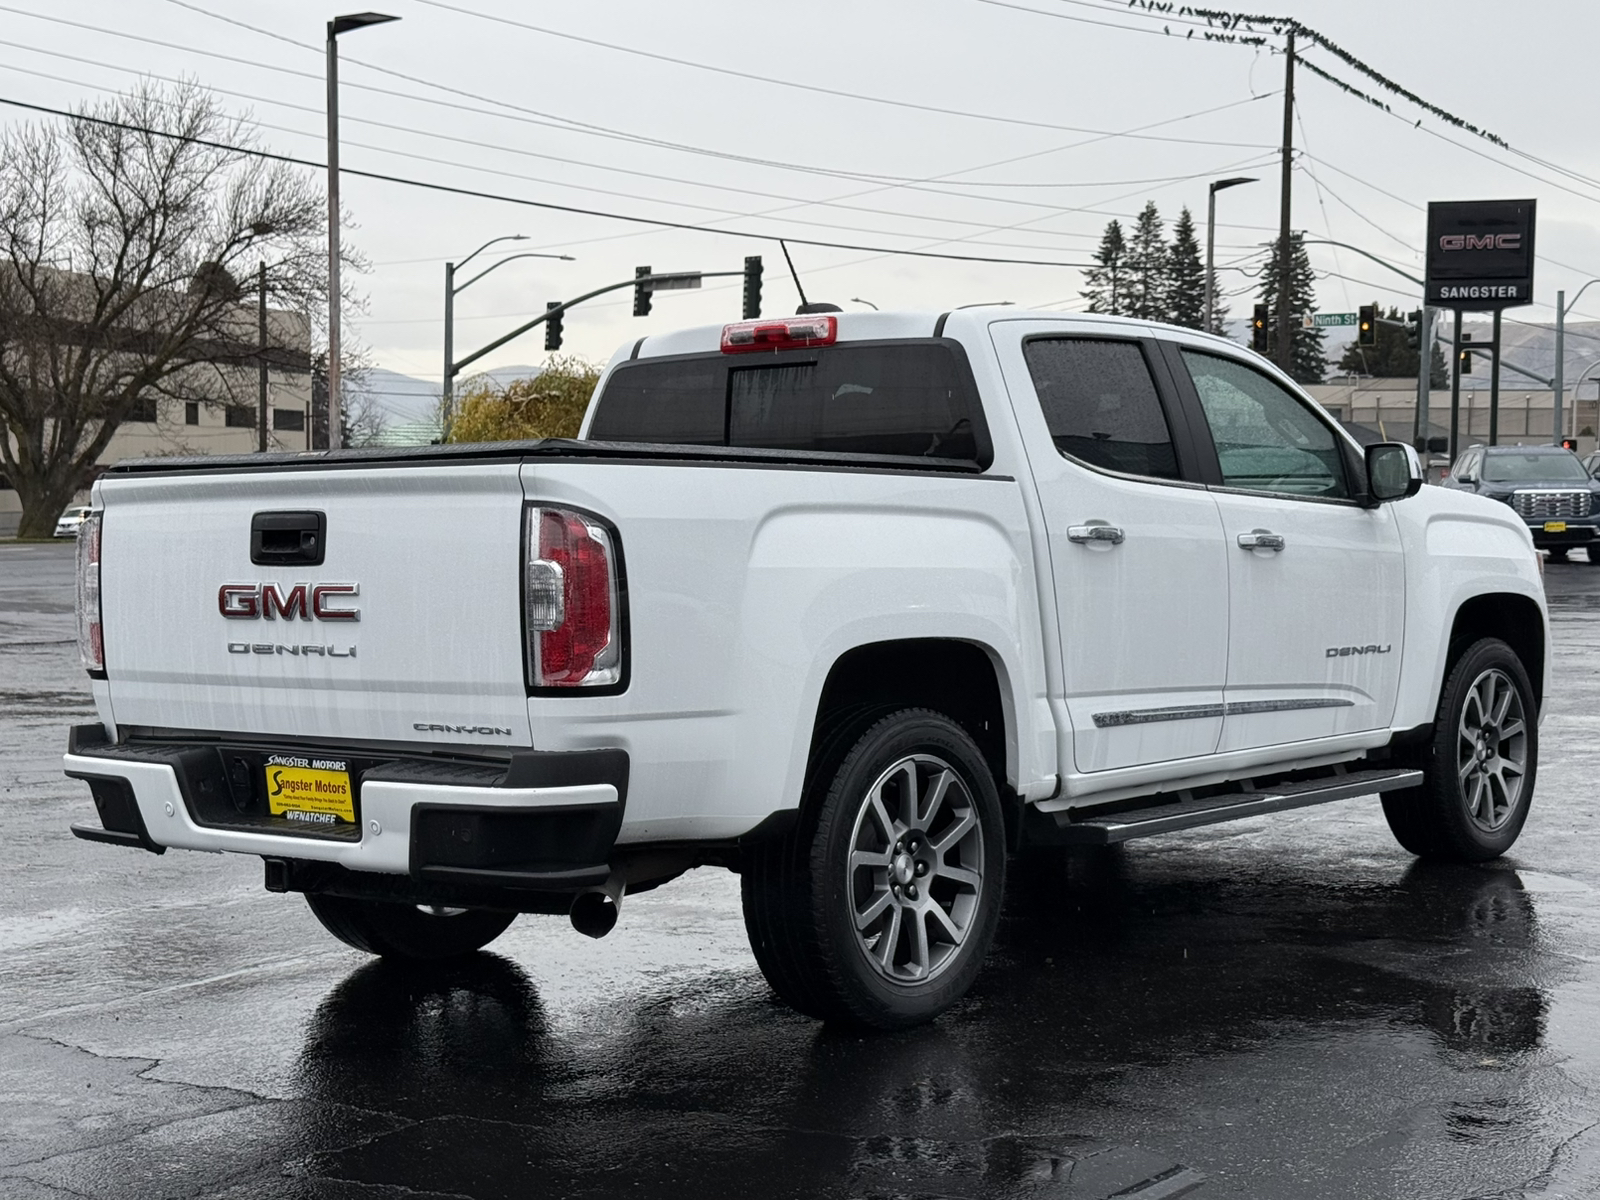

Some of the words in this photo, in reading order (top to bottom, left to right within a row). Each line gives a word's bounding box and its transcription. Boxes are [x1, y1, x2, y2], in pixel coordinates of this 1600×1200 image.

[1439, 233, 1521, 250] GMC
[1440, 286, 1517, 299] SANGSTER
[1315, 314, 1341, 325] Ninth
[1344, 313, 1355, 324] St
[218, 581, 361, 622] GMC
[228, 642, 357, 658] DENALI
[1325, 644, 1391, 658] DENALI
[413, 723, 512, 736] CANYON
[263, 754, 310, 768] SANGSTER
[312, 759, 346, 771] MOTORS
[271, 770, 313, 796] Sangster
[286, 810, 336, 824] WENATCHEE
